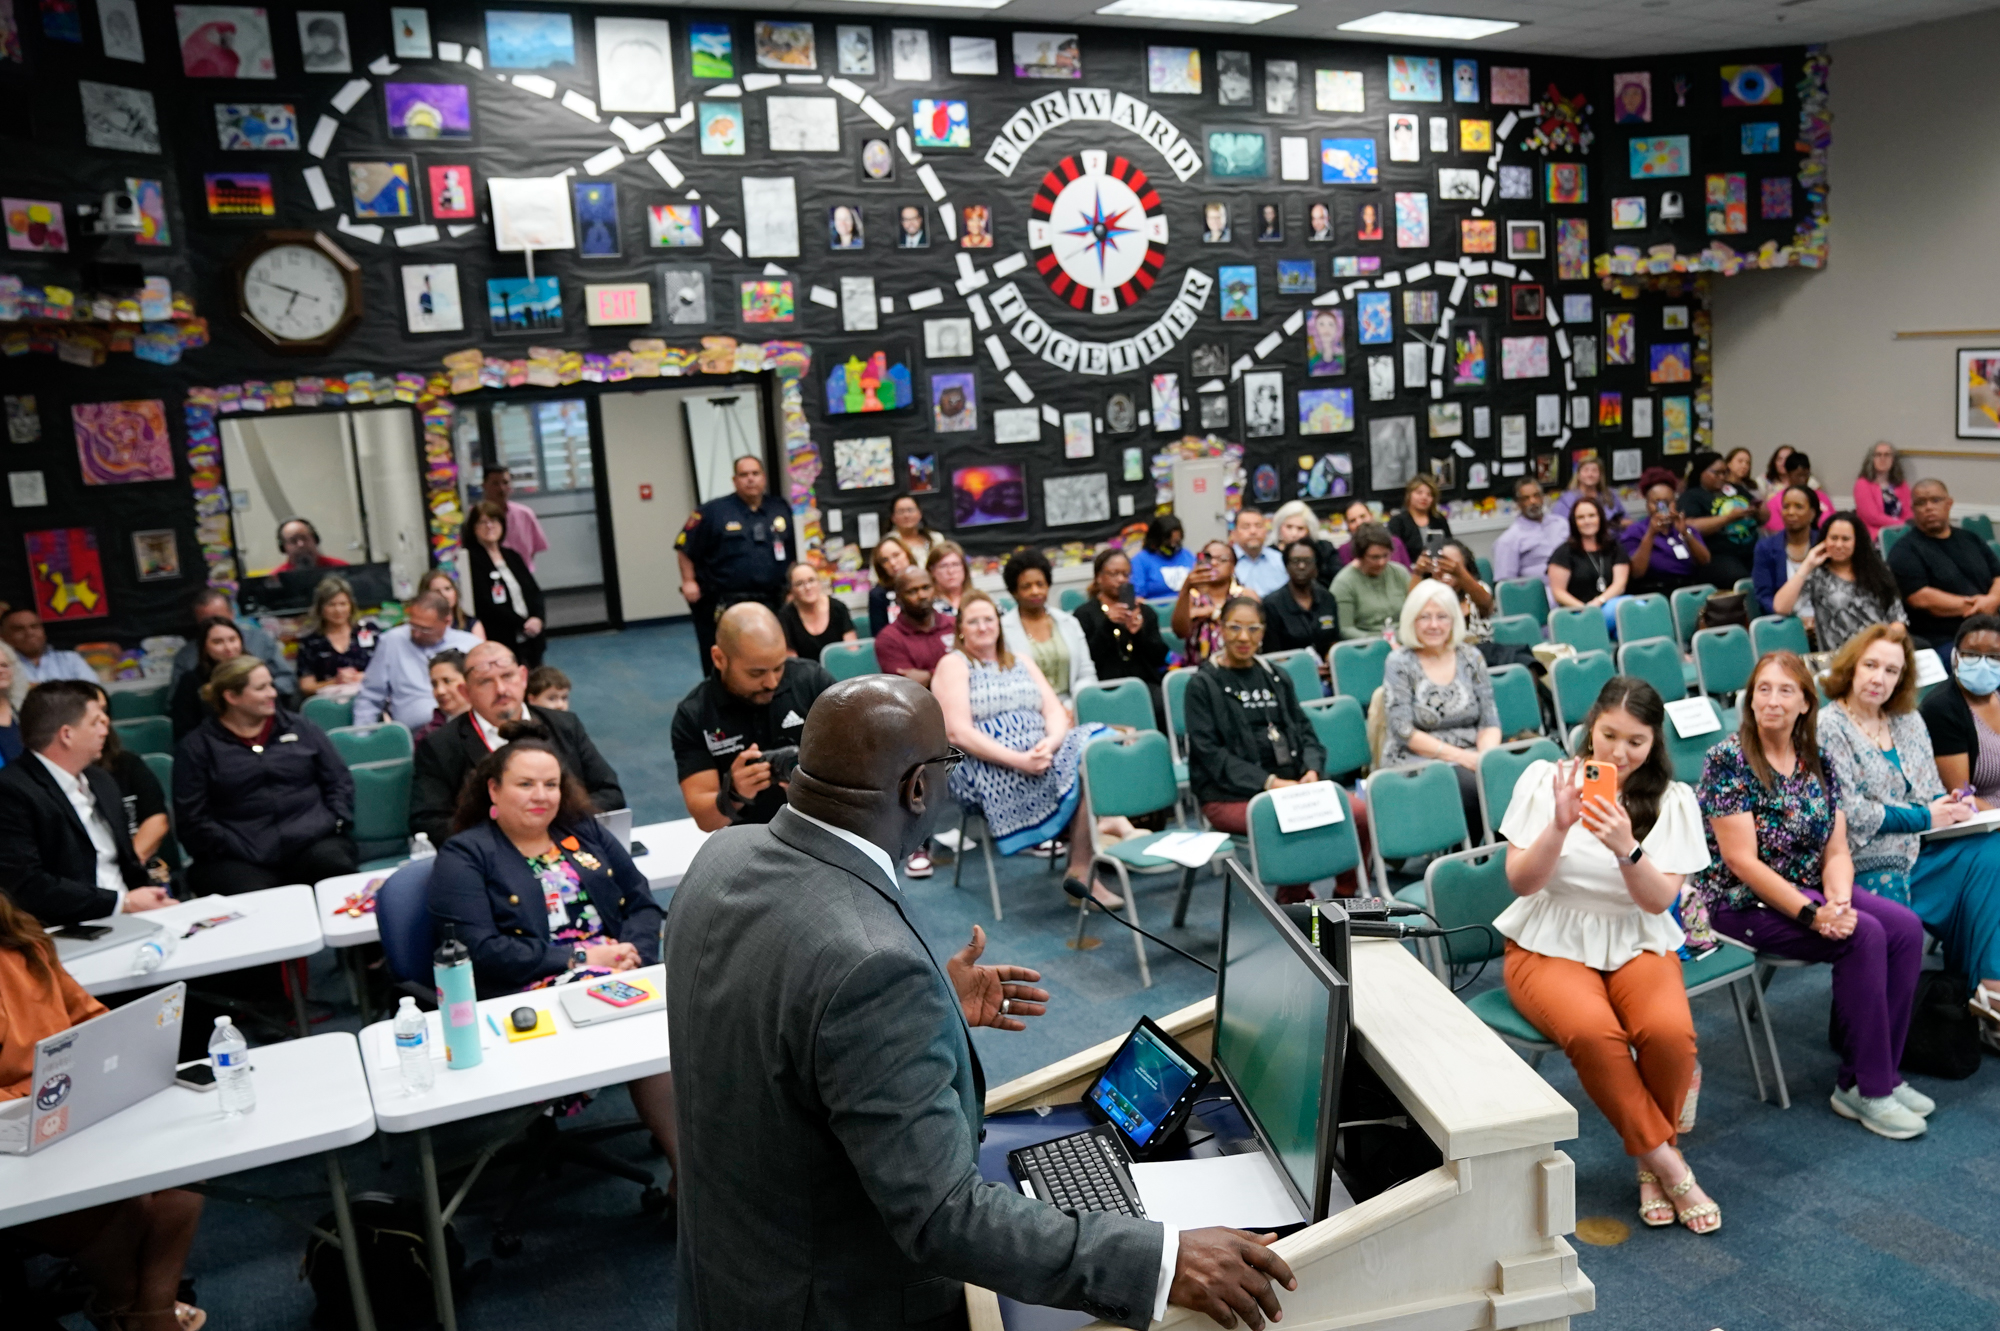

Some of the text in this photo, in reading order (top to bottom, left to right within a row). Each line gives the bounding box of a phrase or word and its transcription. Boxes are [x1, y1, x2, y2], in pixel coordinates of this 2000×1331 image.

[989, 92, 1195, 171] FORWARD
[598, 290, 637, 319] EXIT
[997, 278, 1207, 370] TOGETHER
